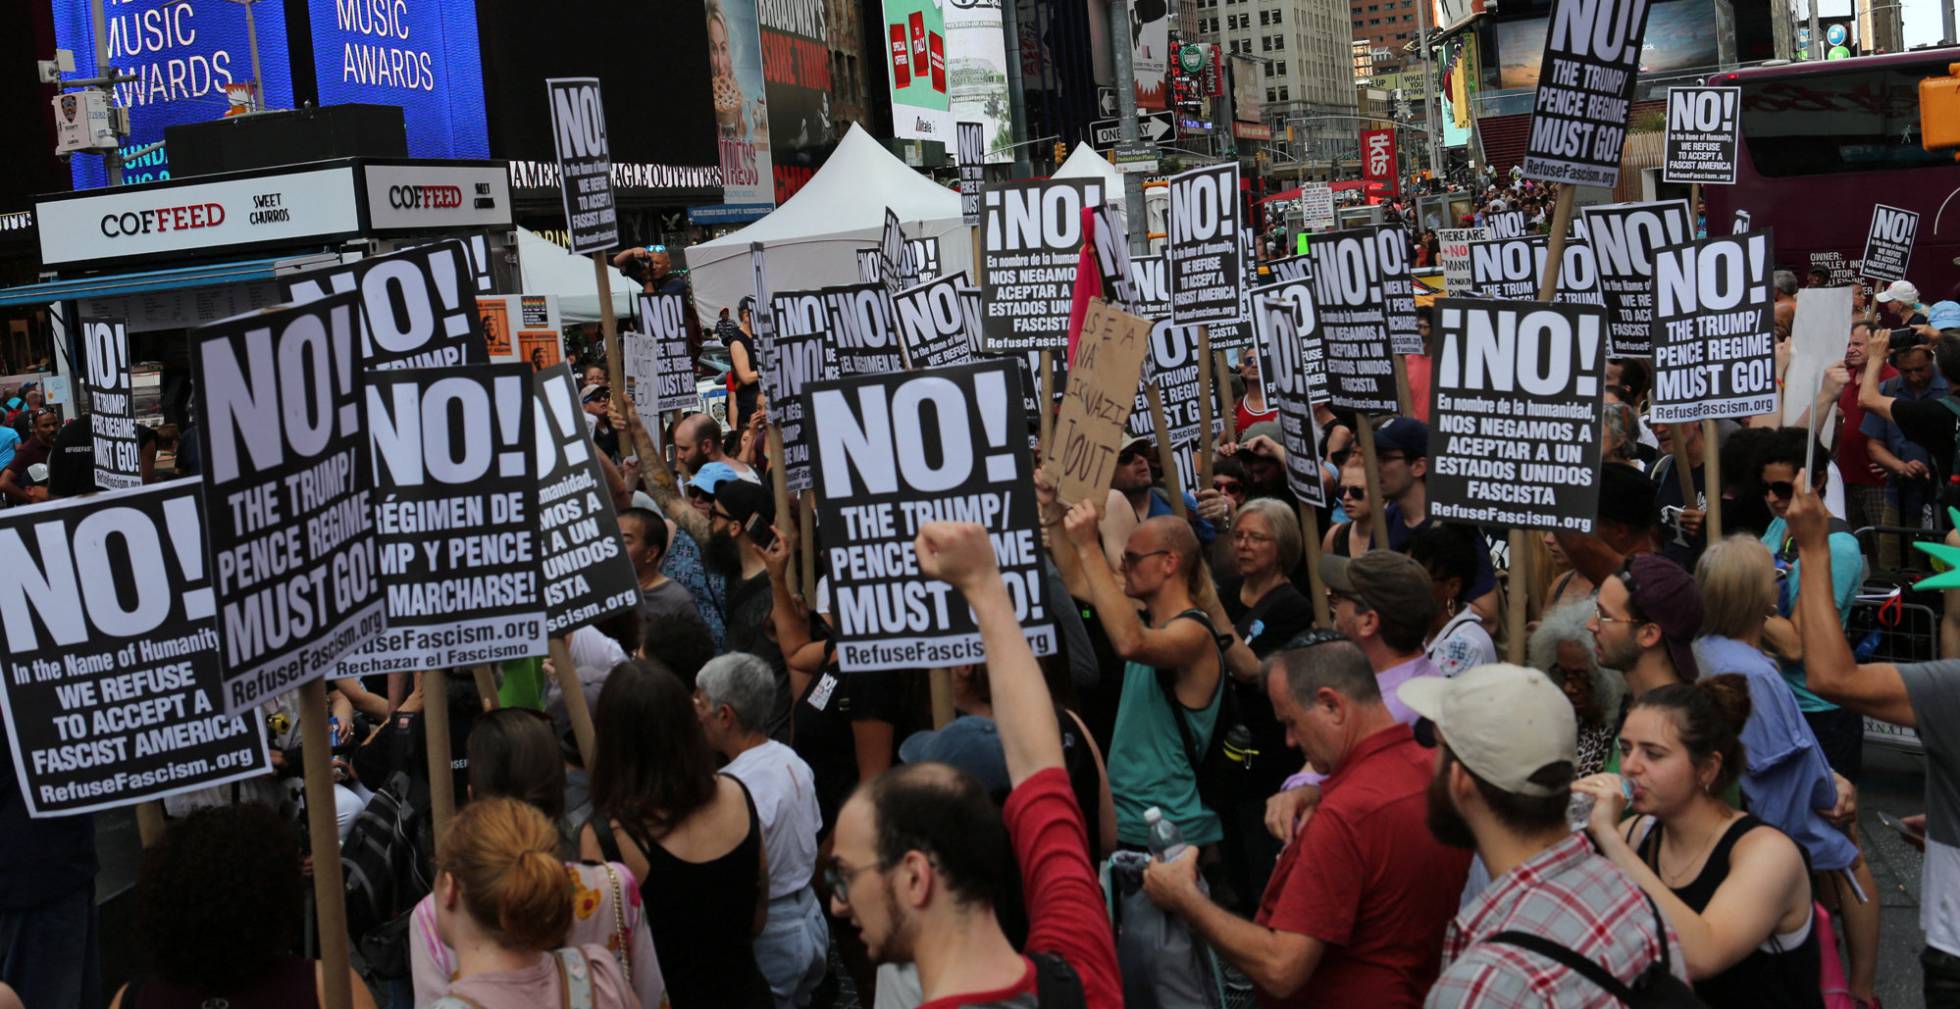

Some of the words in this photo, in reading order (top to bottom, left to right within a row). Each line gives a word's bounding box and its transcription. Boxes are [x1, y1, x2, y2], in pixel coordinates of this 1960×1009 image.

[107, 3, 196, 58] MUSIC
[336, 0, 409, 39] MUSIC
[1550, 0, 1647, 65] NO!
[343, 42, 434, 91] AWARDS
[1553, 58, 1581, 87] THE
[1584, 64, 1629, 98] TRUMP/
[554, 84, 608, 159] NO!
[1537, 86, 1587, 117] PENCE
[1587, 94, 1629, 124] REGIME
[1671, 91, 1735, 133] NO!
[958, 124, 983, 165] NO!
[1101, 129, 1121, 142] ONE
[1367, 132, 1392, 176] tkts
[1530, 115, 1594, 159] MUST
[1594, 125, 1625, 163] GO!
[1693, 143, 1720, 151] REFUSE
[1669, 161, 1696, 170] FASCIST
[1697, 161, 1732, 171] AMERICA
[1688, 152, 1716, 160] ACCEPT
[249, 208, 291, 226] CHURROS
[253, 193, 282, 209] SWEET
[389, 185, 463, 210] COFFEED
[985, 183, 1100, 251] ¡NO!
[1170, 171, 1234, 246] NO!
[100, 202, 226, 238] COFFEED
[1489, 210, 1527, 240] ¡NO!
[1872, 207, 1916, 246] NO!
[986, 255, 997, 268] En
[999, 254, 1029, 268] nombre
[1030, 253, 1041, 266] de
[1042, 252, 1051, 265] la
[1589, 208, 1684, 276] NO!
[1810, 252, 1842, 261] OWNER:
[989, 270, 1016, 285] NOS
[1019, 267, 1077, 283] NEGAMO
[1309, 235, 1383, 307] ¡NO!
[1656, 235, 1767, 318] NO!
[988, 301, 1047, 317] ESTADOS
[996, 284, 1057, 300] ACEPTAR
[1060, 283, 1071, 298] A
[1198, 286, 1236, 303] AMERICA
[639, 294, 688, 340] NO!
[775, 294, 832, 342] ¡NO!
[828, 287, 897, 349] ¡NO!
[1611, 323, 1650, 337] FASCIST
[1619, 308, 1633, 322] TO
[1665, 320, 1694, 343] THE
[1696, 309, 1763, 338] TRUMP/
[83, 322, 130, 390] NO!
[1438, 308, 1600, 397] ¡NO!
[1656, 341, 1703, 368] PENCE
[1708, 332, 1772, 361] REGIME
[200, 303, 359, 486] NO!
[1656, 363, 1724, 401] MUST
[1731, 358, 1774, 394] GO!
[105, 416, 136, 439] REGIME
[1437, 393, 1452, 410] En
[1454, 396, 1495, 413] nombre
[1497, 399, 1510, 414] de
[1513, 399, 1524, 416] la
[1527, 399, 1596, 423] humanidad,
[1655, 398, 1774, 420] RefuseFascism.org
[811, 369, 1018, 499] NO!
[1439, 415, 1475, 434] NOS
[1480, 419, 1573, 442] NEGAMOS
[1578, 424, 1592, 443] A
[116, 441, 140, 473] GO!
[1446, 436, 1530, 460] ACEPTAR
[1535, 443, 1550, 461] A
[1555, 444, 1582, 464] UN
[1435, 456, 1516, 480] ESTADOS
[1520, 463, 1593, 486] UNIDOS
[228, 481, 282, 537] THE
[285, 446, 357, 518] TRUMP/
[491, 491, 525, 524] DE
[587, 492, 603, 514] A
[1467, 480, 1556, 505] FASCISTA
[551, 530, 568, 555] A
[571, 516, 600, 544] UN
[840, 502, 897, 541] THE
[900, 491, 1011, 537] TRUMP/
[1430, 501, 1592, 532] RefuseFascism.org
[217, 523, 304, 597] PENCE
[307, 489, 373, 561] REGIME
[422, 540, 441, 573] Y
[449, 530, 533, 570] PENCE
[542, 536, 619, 581] UNIDOS
[829, 541, 919, 582] PENCE
[0, 494, 217, 655] NO!
[387, 571, 537, 618] MARCHARSE!
[223, 563, 328, 669] MUST
[332, 536, 378, 615] GO!
[836, 580, 952, 637] MUST
[12, 662, 31, 685] In
[32, 655, 63, 682] the
[64, 648, 114, 678] Name
[117, 644, 138, 669] of
[139, 628, 220, 663] Humanity
[231, 608, 383, 710] RefuseFascism.org
[335, 656, 420, 677] Rechazar
[426, 652, 442, 667] el
[449, 644, 529, 665] Fascismo
[845, 630, 1050, 666] RefuseFascisrg
[56, 682, 97, 711] WE
[100, 661, 197, 704] REFUSE
[53, 715, 88, 742] TO
[92, 693, 187, 735] ACCEPT
[194, 689, 213, 715] A
[31, 736, 129, 776] FASCIST
[135, 715, 249, 760] AMERICA
[39, 747, 255, 804] RefuseFascism.org
